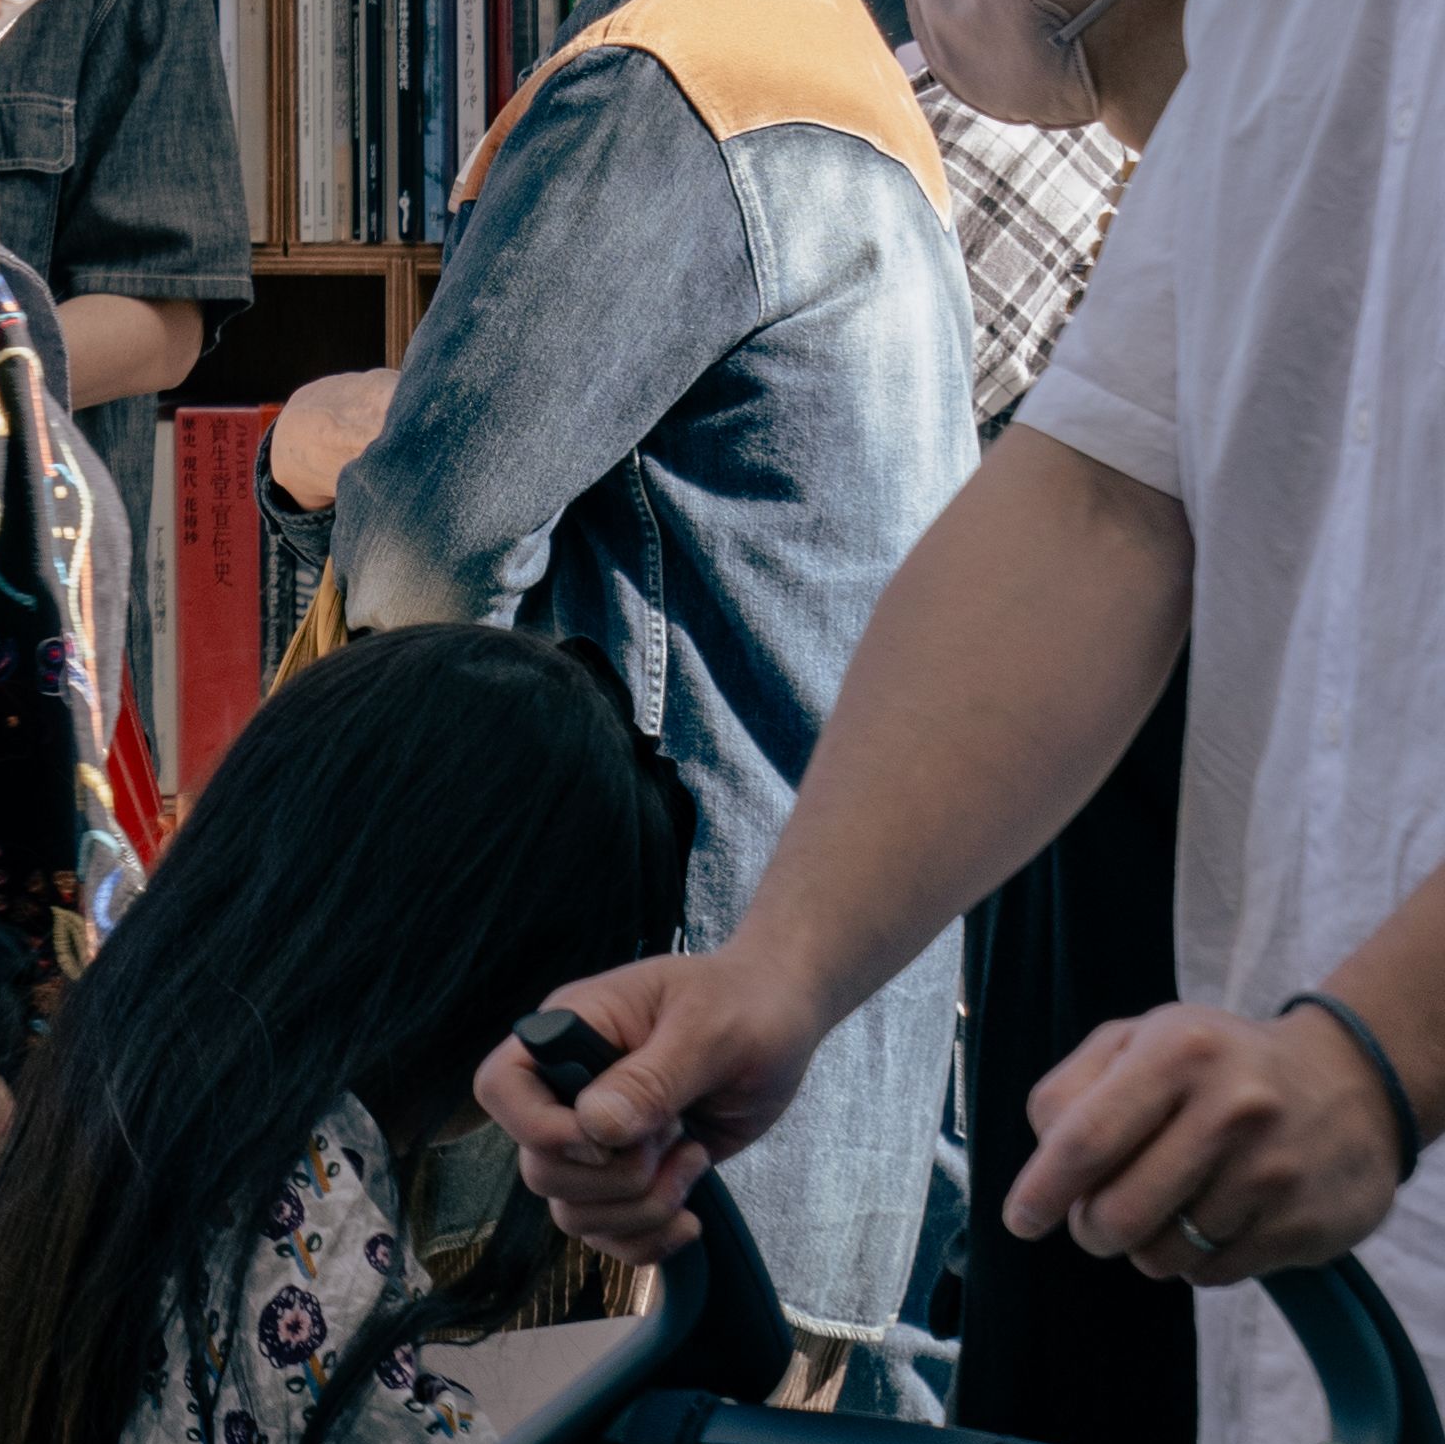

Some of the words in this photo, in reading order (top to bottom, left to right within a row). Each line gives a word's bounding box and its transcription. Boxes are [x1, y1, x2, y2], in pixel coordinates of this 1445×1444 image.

[210, 416, 233, 588] 資生堂宣伝史
